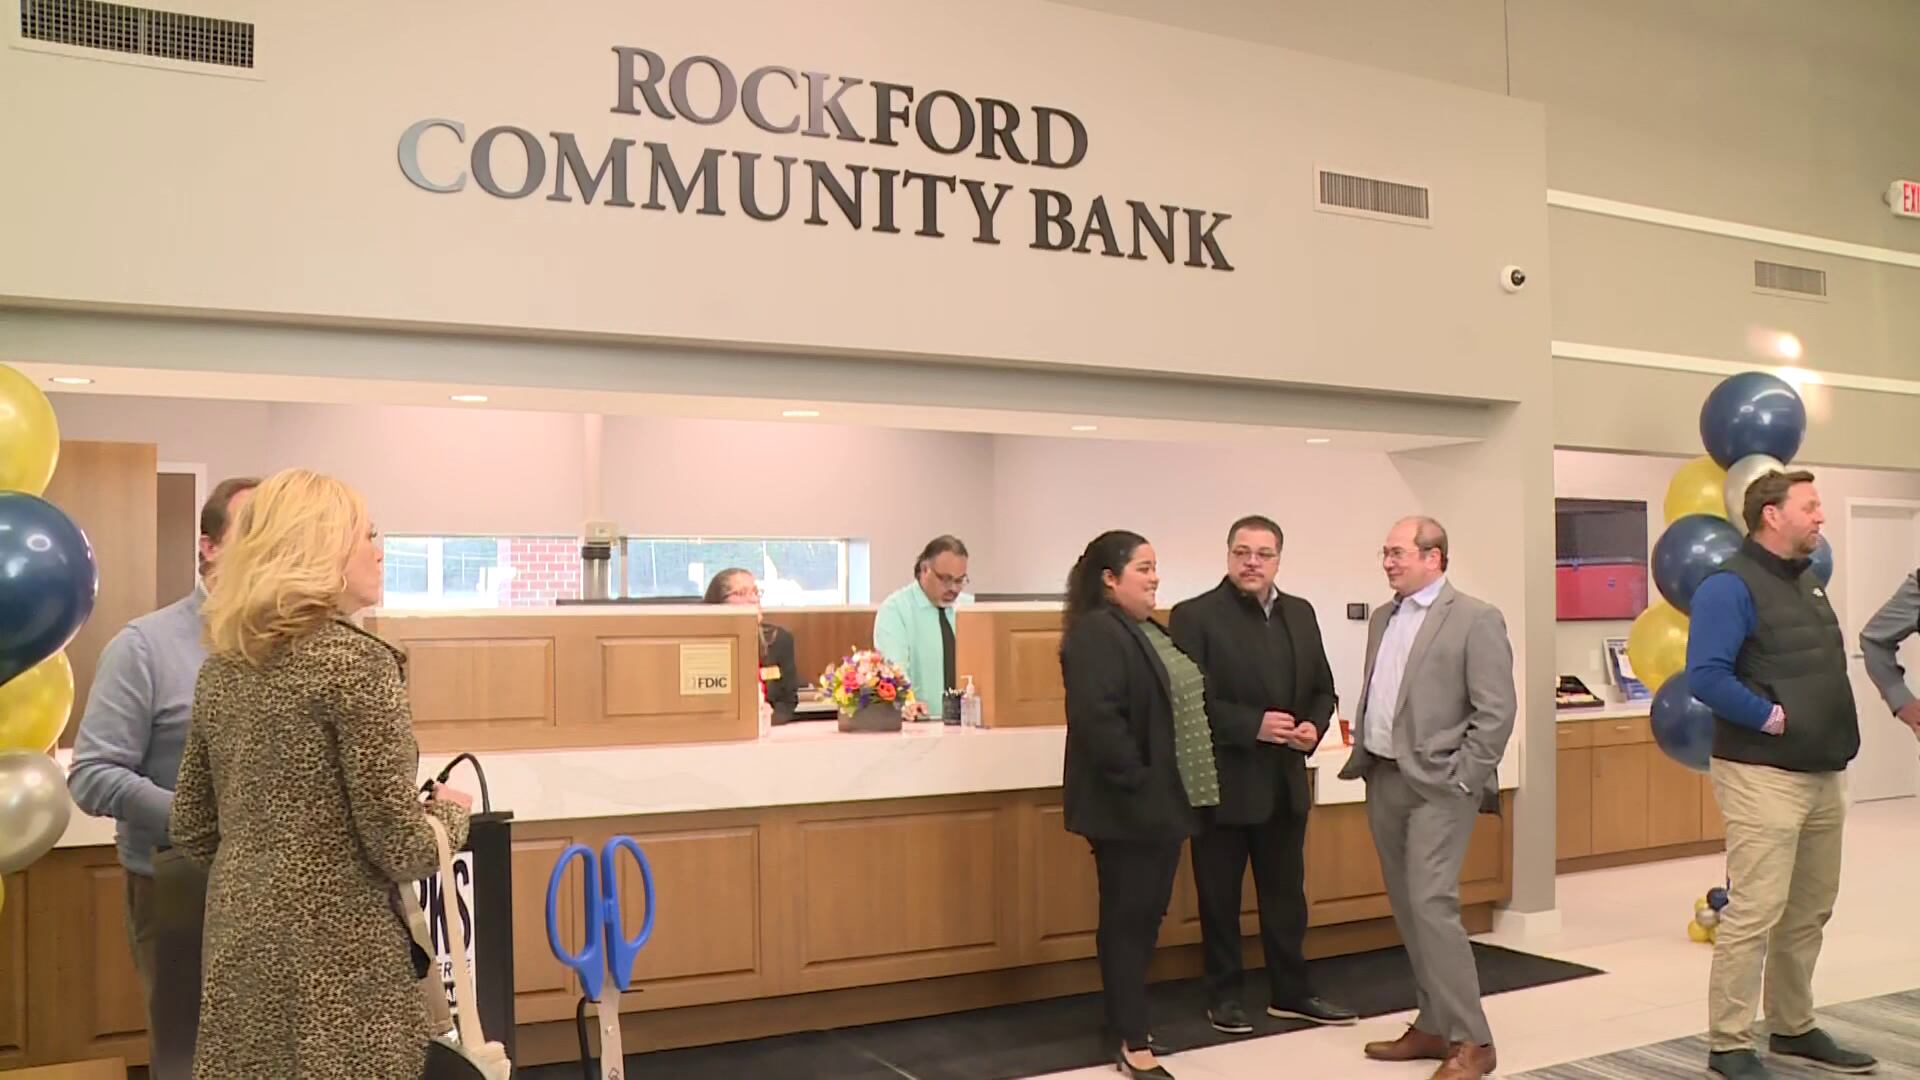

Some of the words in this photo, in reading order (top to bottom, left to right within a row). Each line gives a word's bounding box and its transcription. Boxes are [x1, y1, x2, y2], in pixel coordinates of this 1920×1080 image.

[610, 46, 1088, 170] ROCKFORD
[397, 117, 1013, 245] COMMUNITY
[1029, 187, 1235, 272] BANK
[698, 677, 728, 689] FDIC
